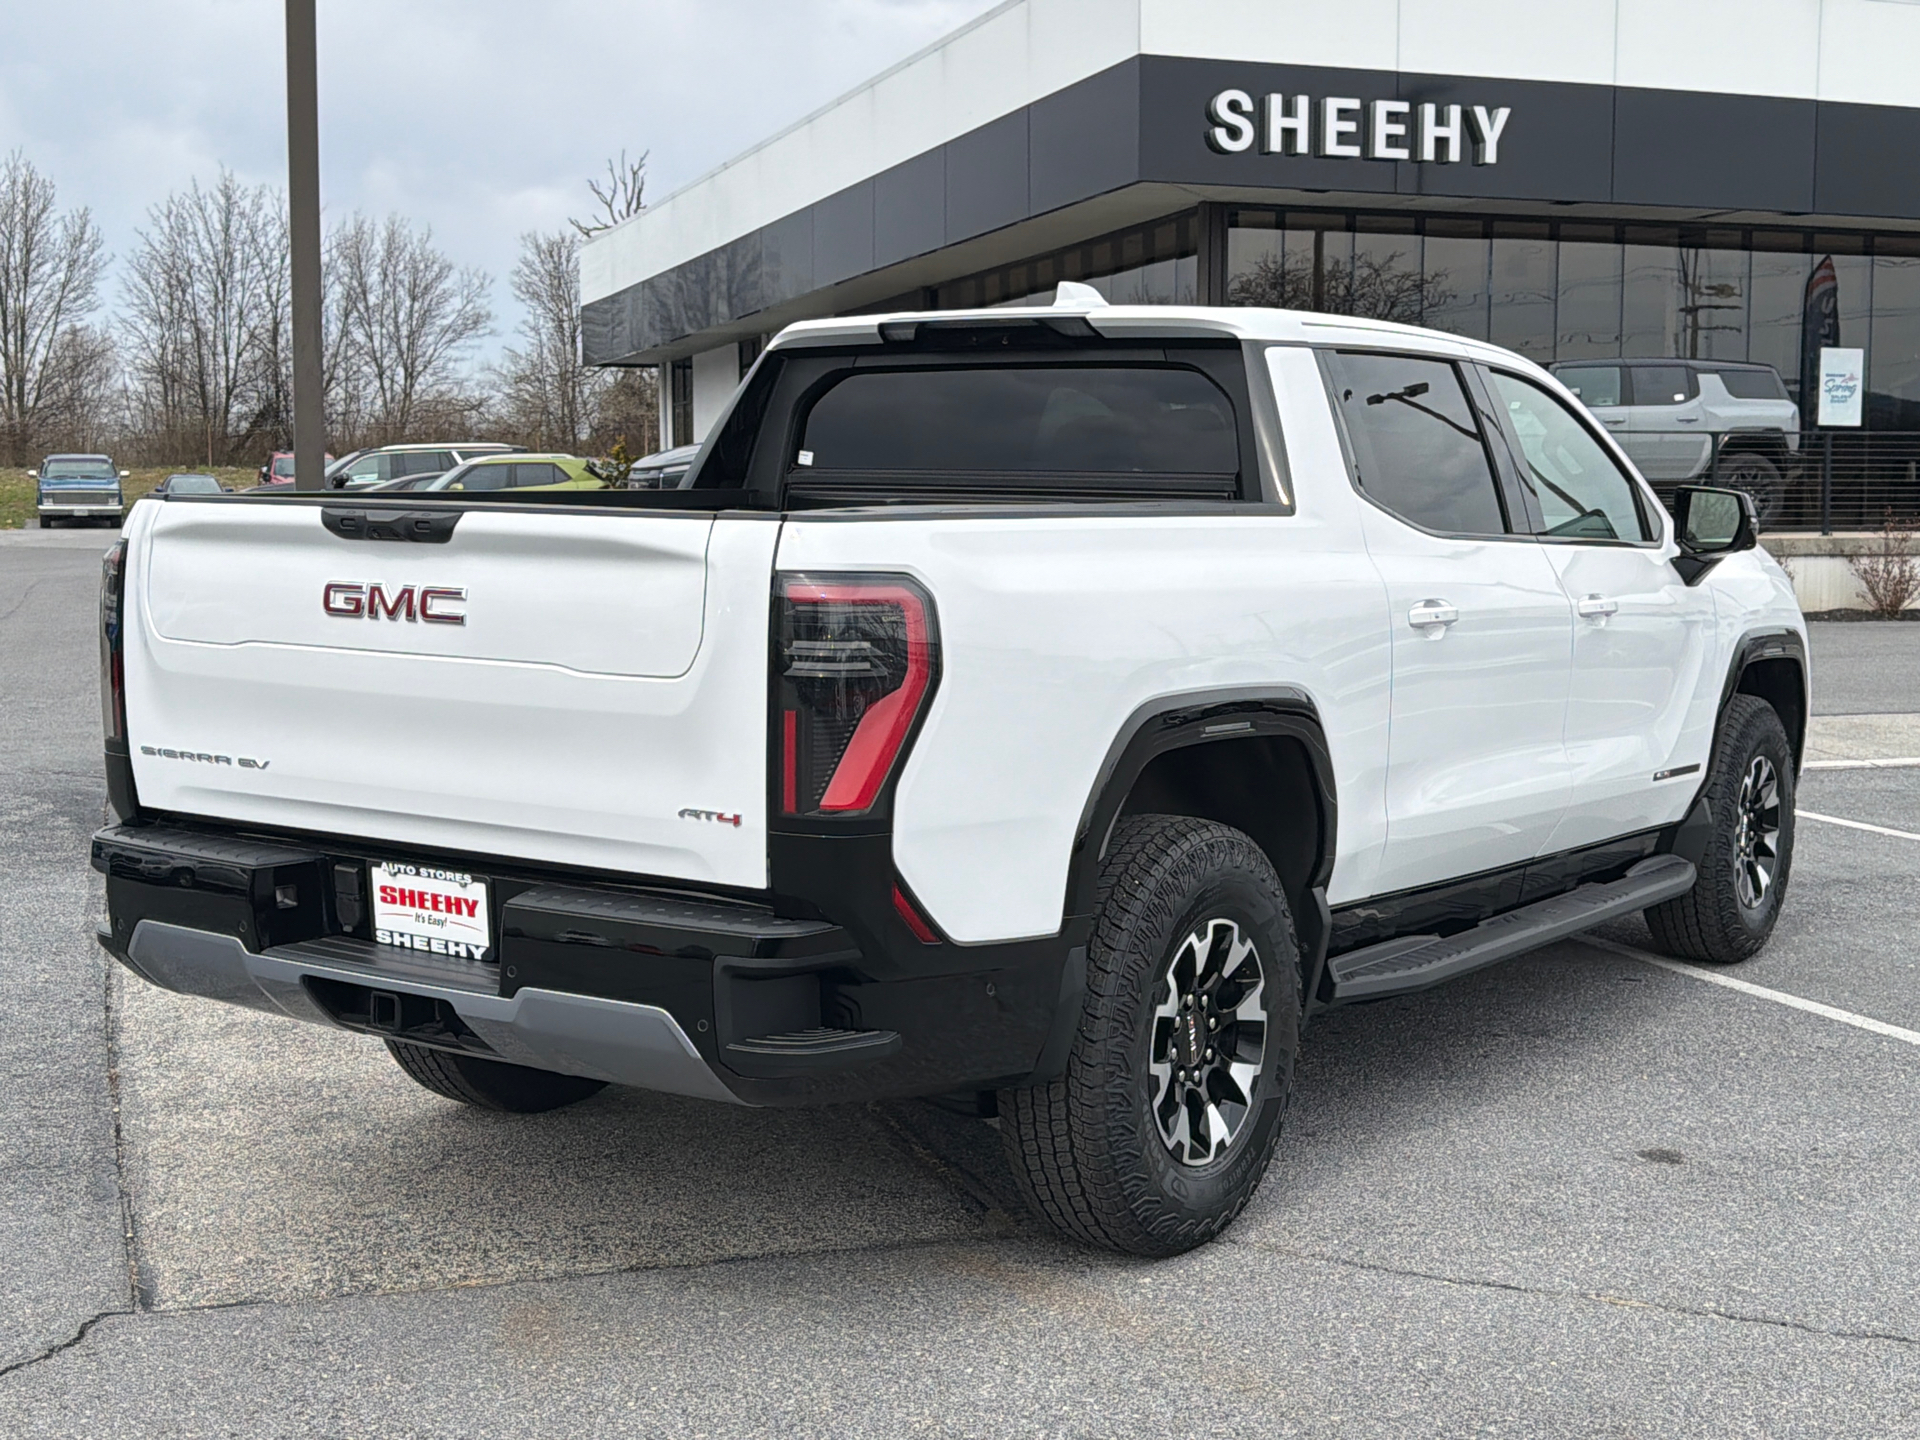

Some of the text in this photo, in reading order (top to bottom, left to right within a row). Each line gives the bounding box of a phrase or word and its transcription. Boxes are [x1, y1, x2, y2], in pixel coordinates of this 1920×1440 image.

[1208, 89, 1511, 164] SHEEHY
[1824, 378, 1857, 398] Spring
[323, 580, 468, 626] GMC
[140, 745, 270, 770] SIERRA EV
[678, 808, 742, 828] AT4
[380, 862, 473, 884] AUTO STORES
[379, 885, 479, 918] SHEEHY
[414, 912, 448, 929] It's Easy!
[375, 930, 487, 960] SHEEHY
